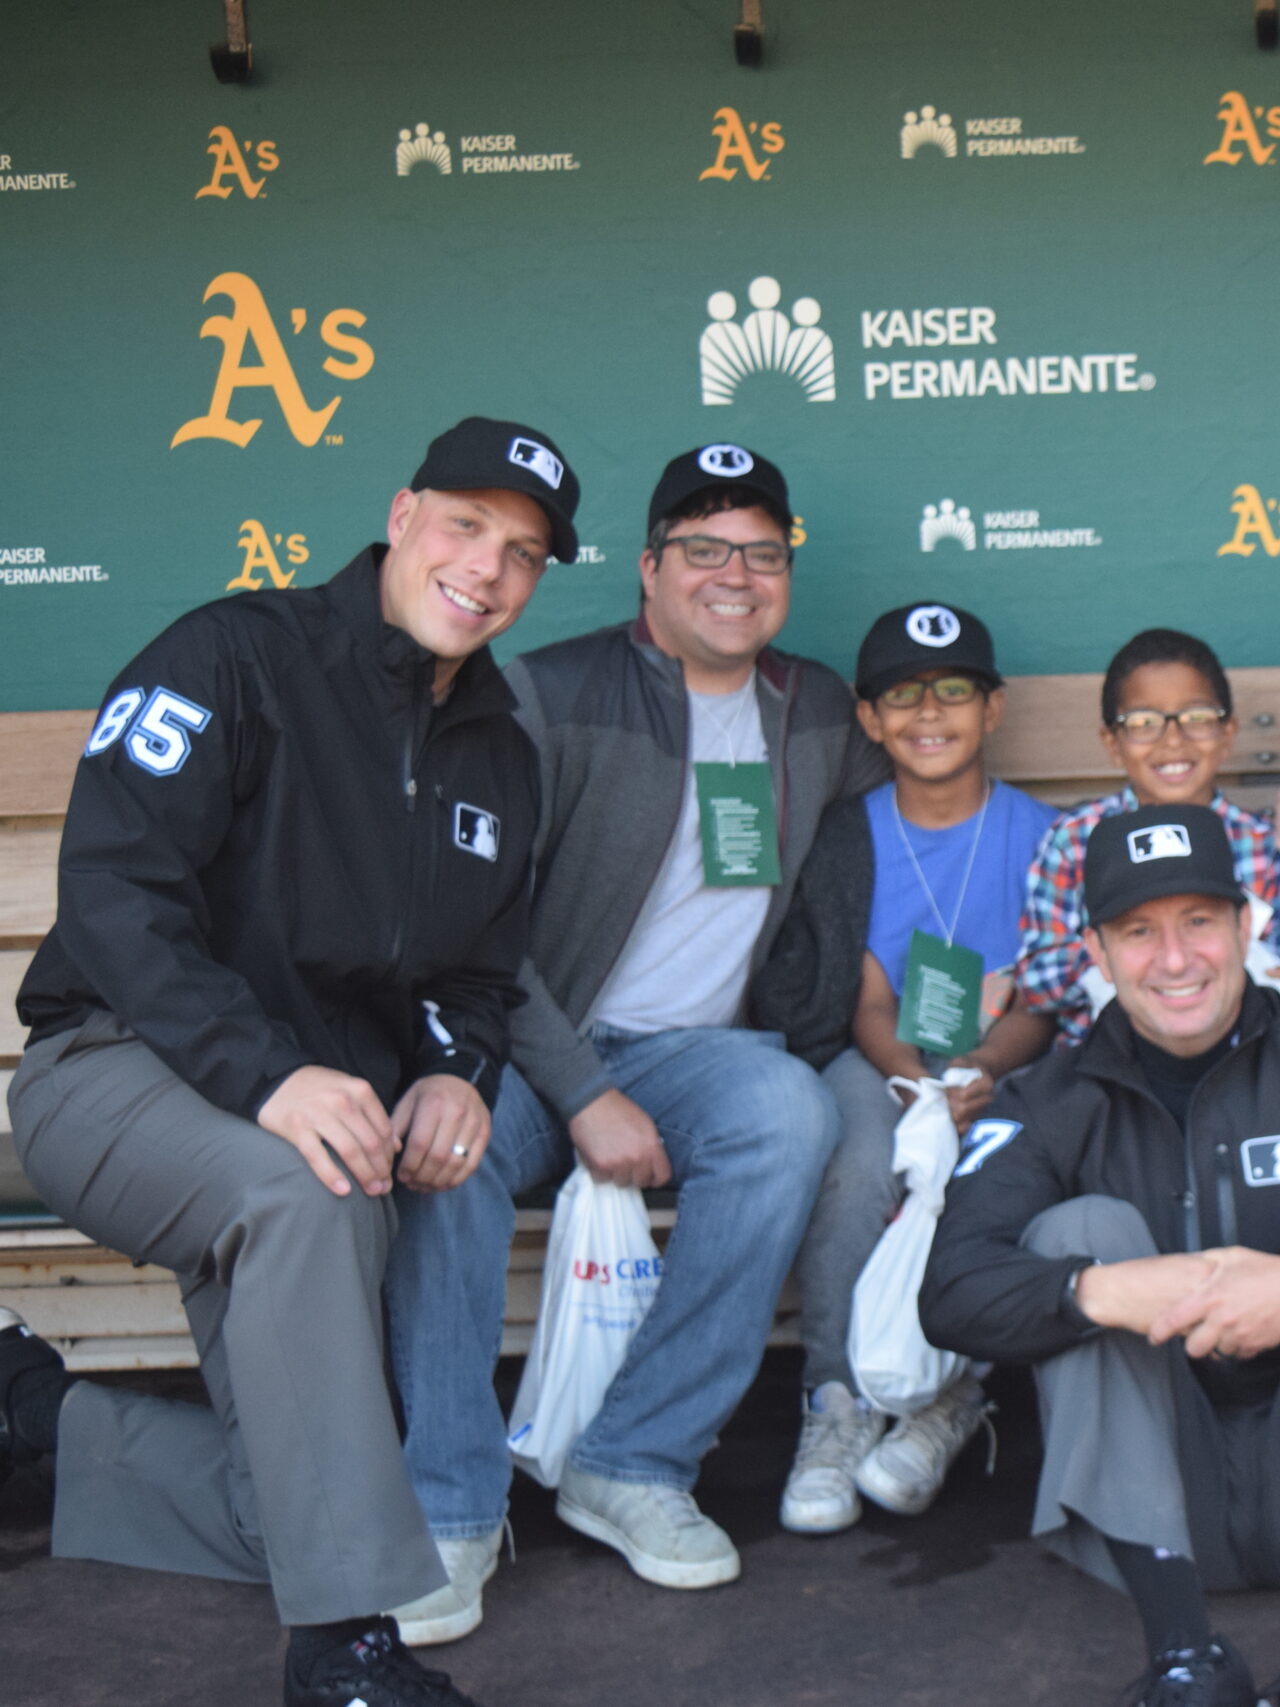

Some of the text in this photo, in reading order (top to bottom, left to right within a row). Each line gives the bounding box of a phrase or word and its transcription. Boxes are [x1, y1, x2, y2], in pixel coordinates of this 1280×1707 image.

[461, 135, 515, 152] KAISER
[700, 108, 784, 180] A's
[966, 118, 1021, 135] KAISER
[196, 126, 279, 198] A's
[462, 154, 573, 173] PERMANENTE
[862, 307, 996, 348] KAISER
[171, 272, 374, 448] A's
[865, 354, 1137, 400] PERMANENTE
[984, 510, 1039, 529] KAISER
[227, 520, 309, 590] A's
[84, 685, 213, 777] 85
